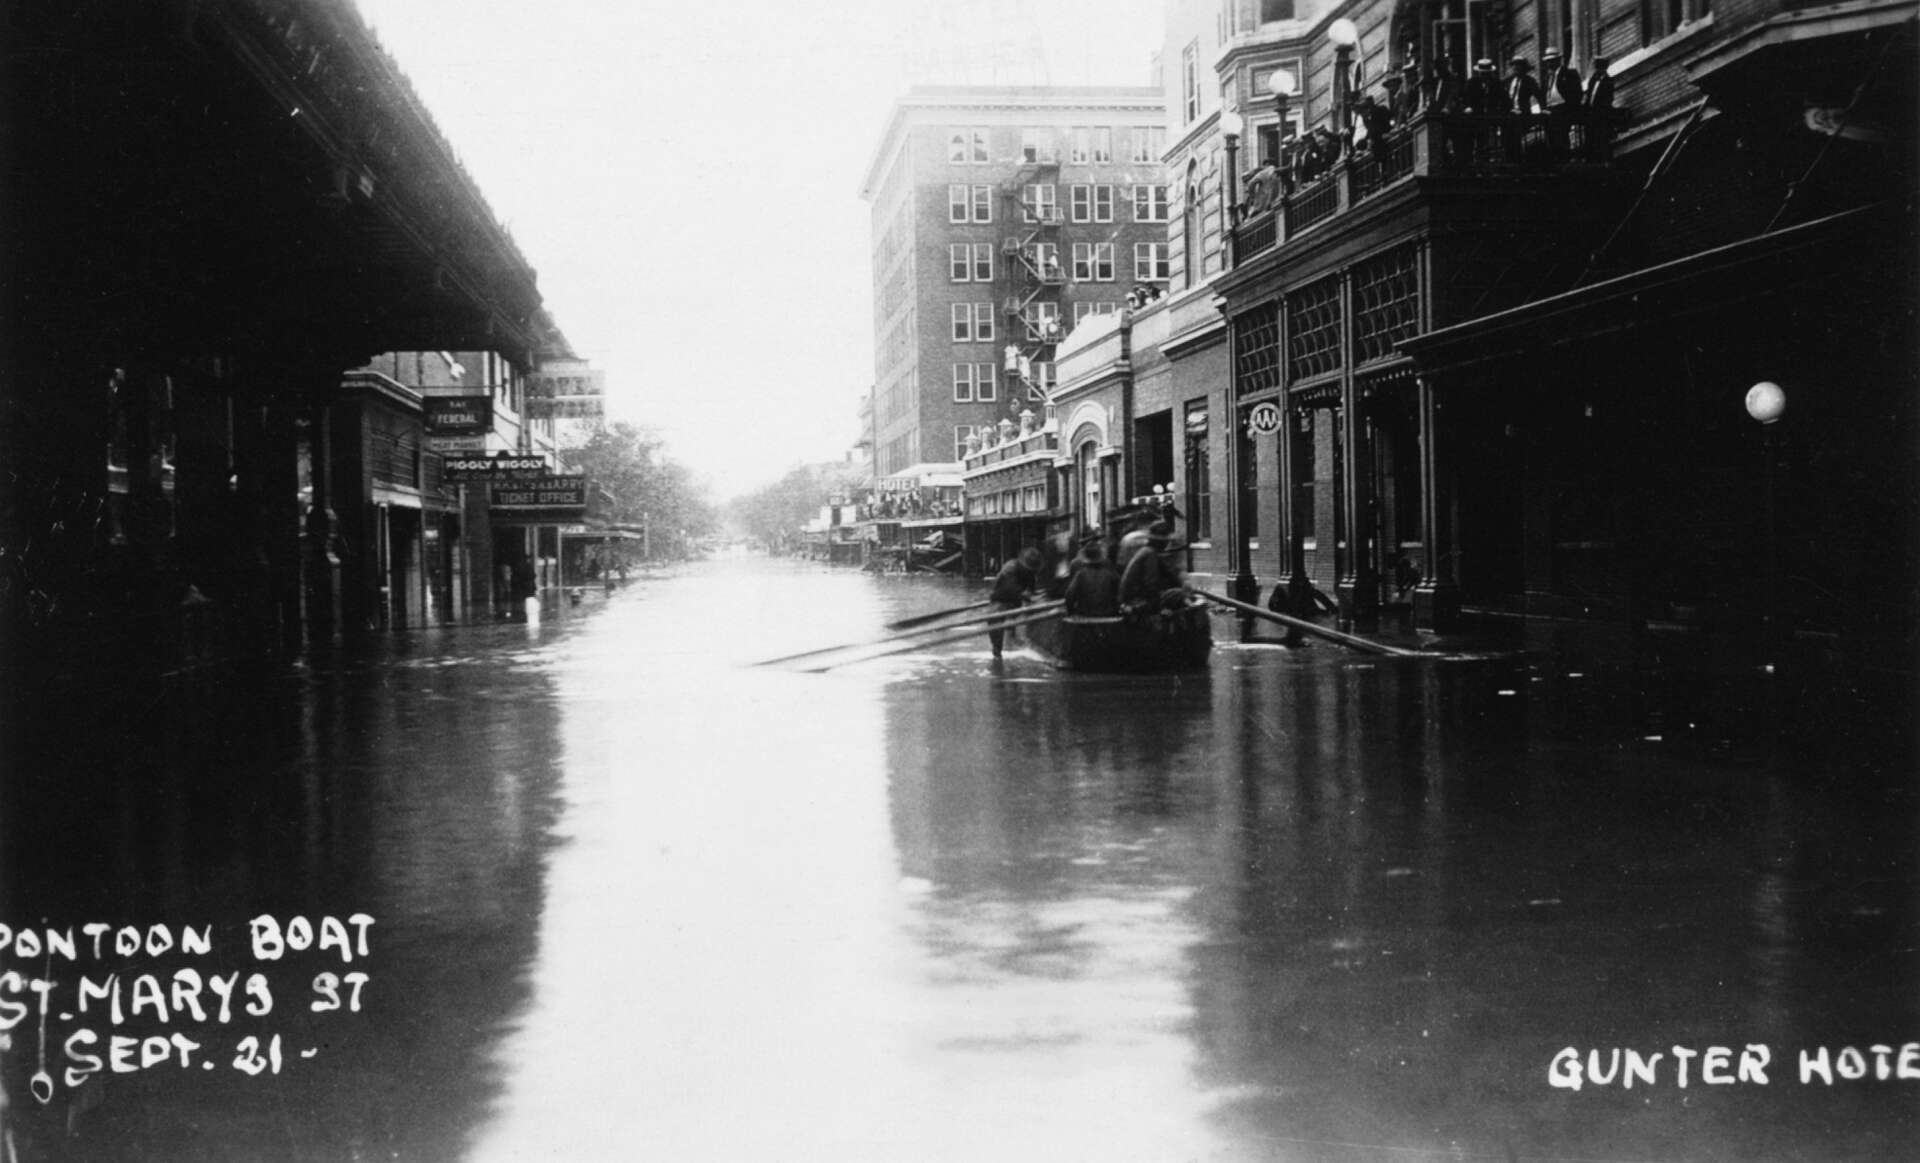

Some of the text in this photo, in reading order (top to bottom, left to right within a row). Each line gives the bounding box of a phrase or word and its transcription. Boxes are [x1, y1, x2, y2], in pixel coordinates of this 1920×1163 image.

[446, 459, 544, 470] PIGGLY WIGGLY
[877, 479, 917, 492] HOTEL
[499, 491, 577, 504] TICKET OFFICE
